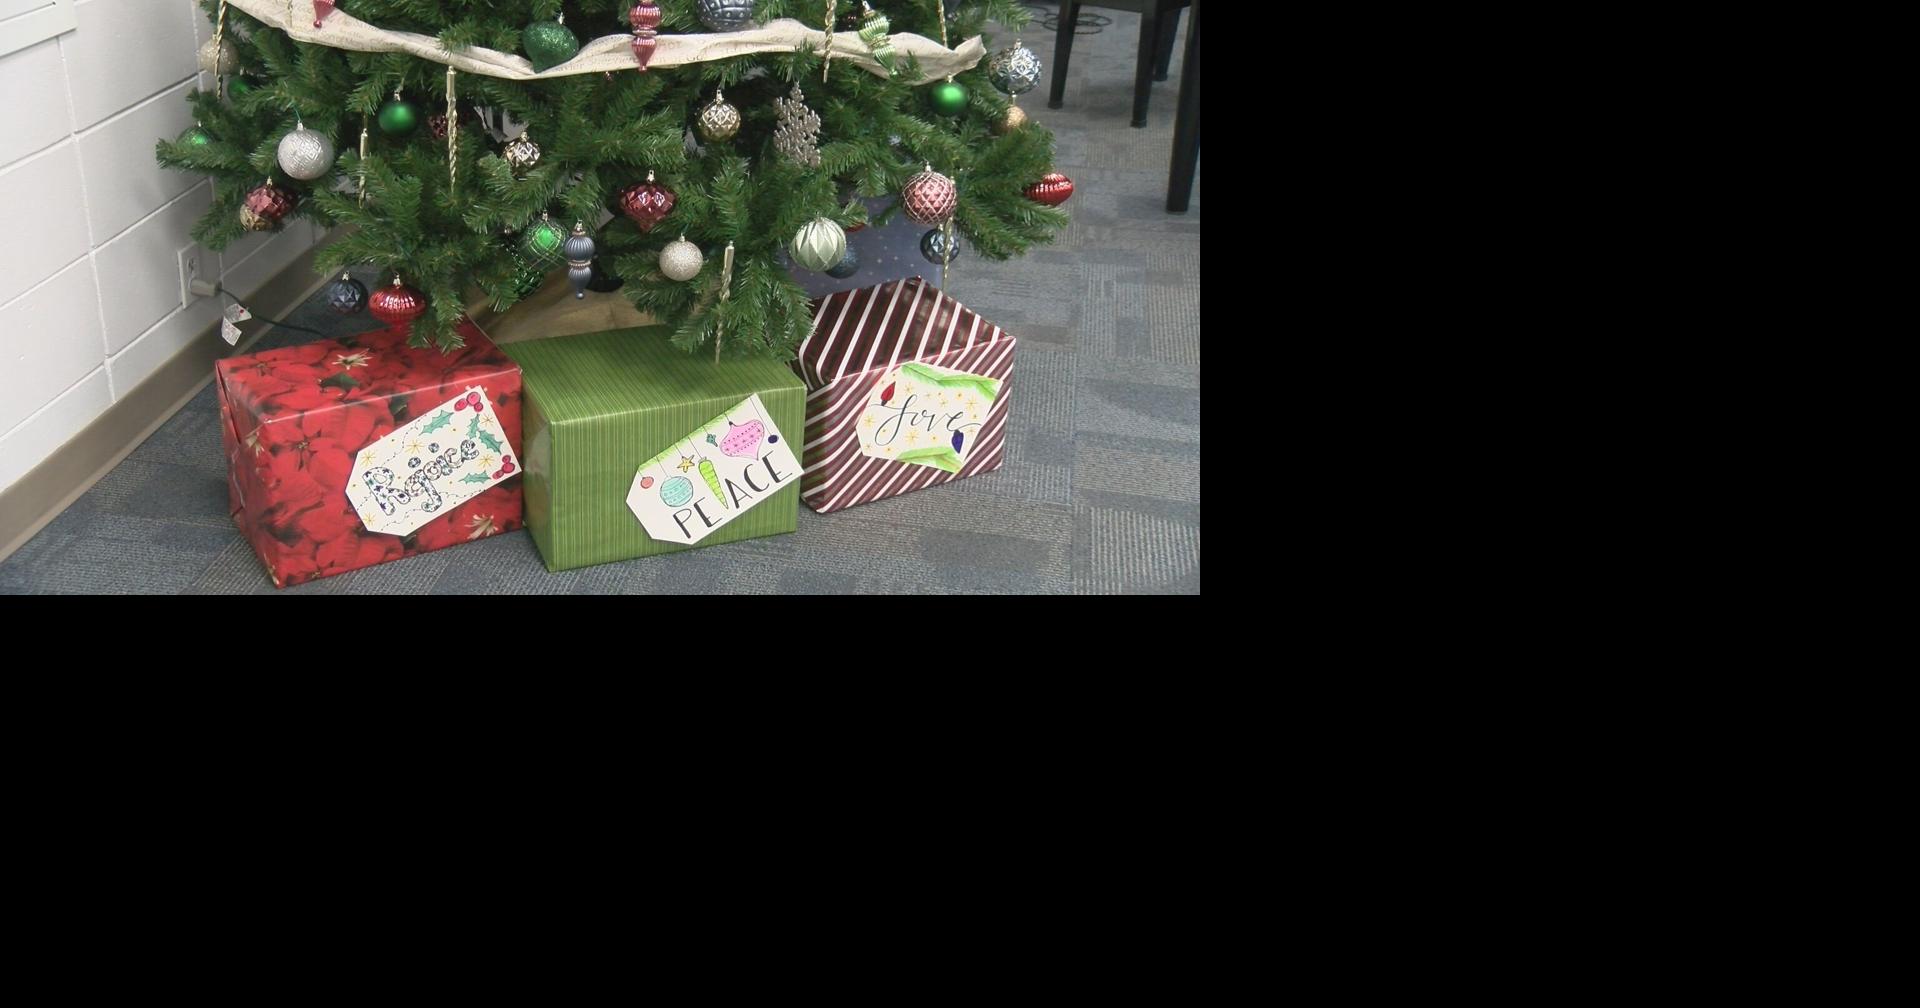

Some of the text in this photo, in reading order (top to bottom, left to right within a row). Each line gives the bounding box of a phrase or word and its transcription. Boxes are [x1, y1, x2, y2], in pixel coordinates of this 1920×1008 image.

[874, 394, 972, 447] Love
[362, 439, 479, 516] Rejoice
[673, 450, 793, 539] PEACE
